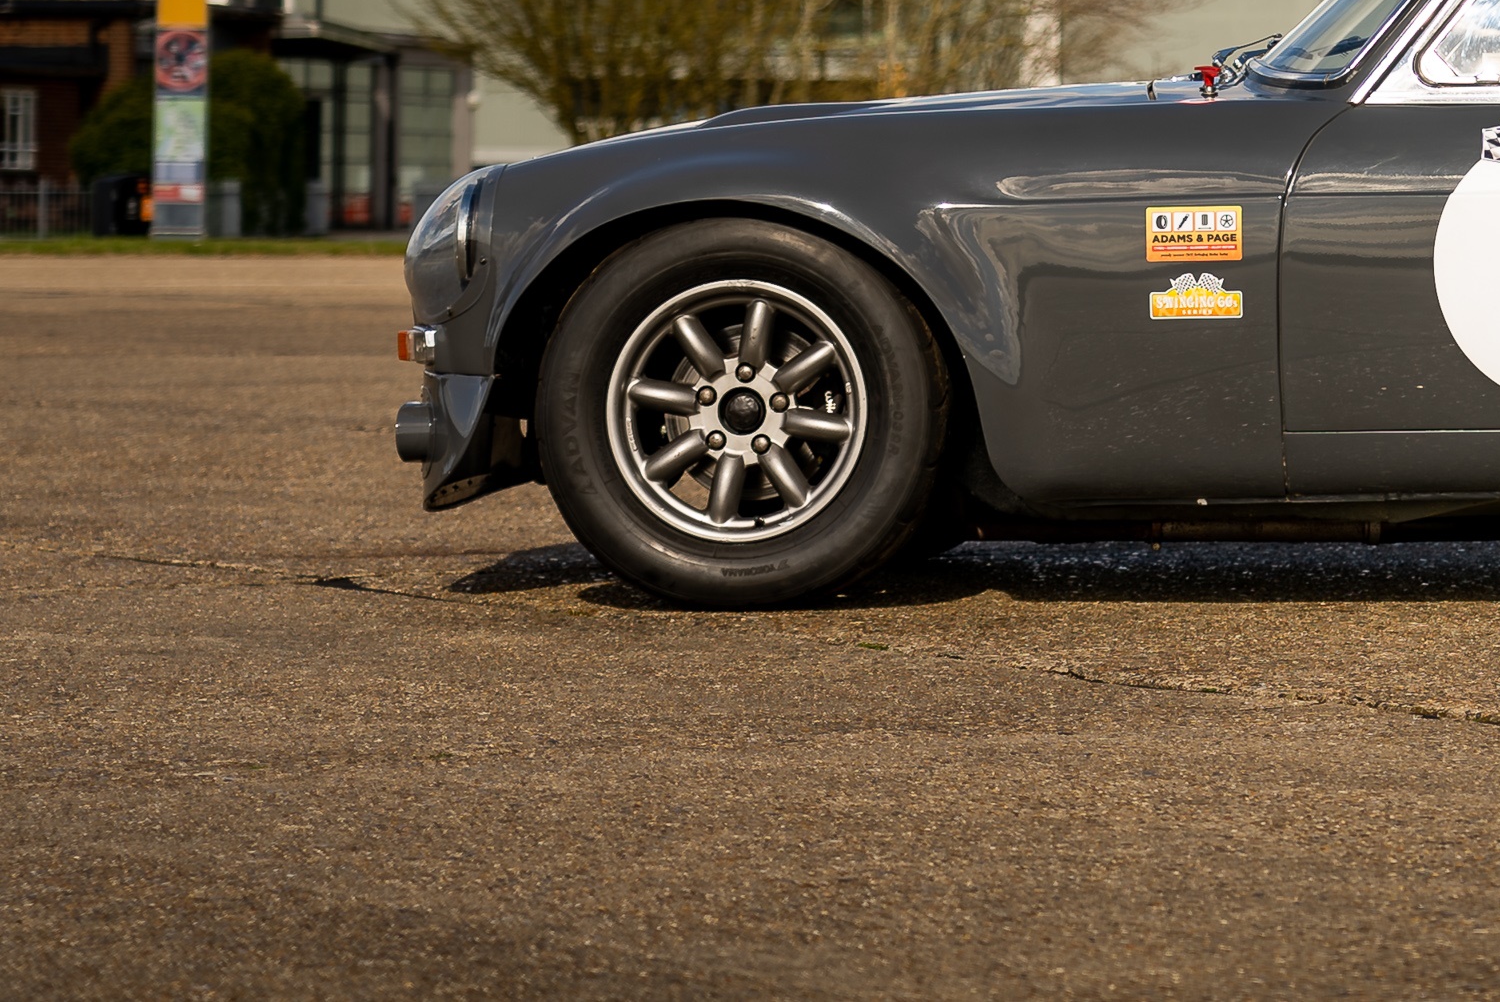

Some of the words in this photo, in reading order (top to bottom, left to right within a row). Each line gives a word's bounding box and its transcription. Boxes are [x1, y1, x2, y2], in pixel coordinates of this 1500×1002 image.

[1152, 234, 1193, 243] ADAMS
[1196, 234, 1204, 243] &
[1207, 233, 1237, 242] PAGE
[1156, 295, 1215, 309] SWINGING
[560, 372, 588, 476] ADVAN
[721, 564, 775, 577] YOKOHAMA
